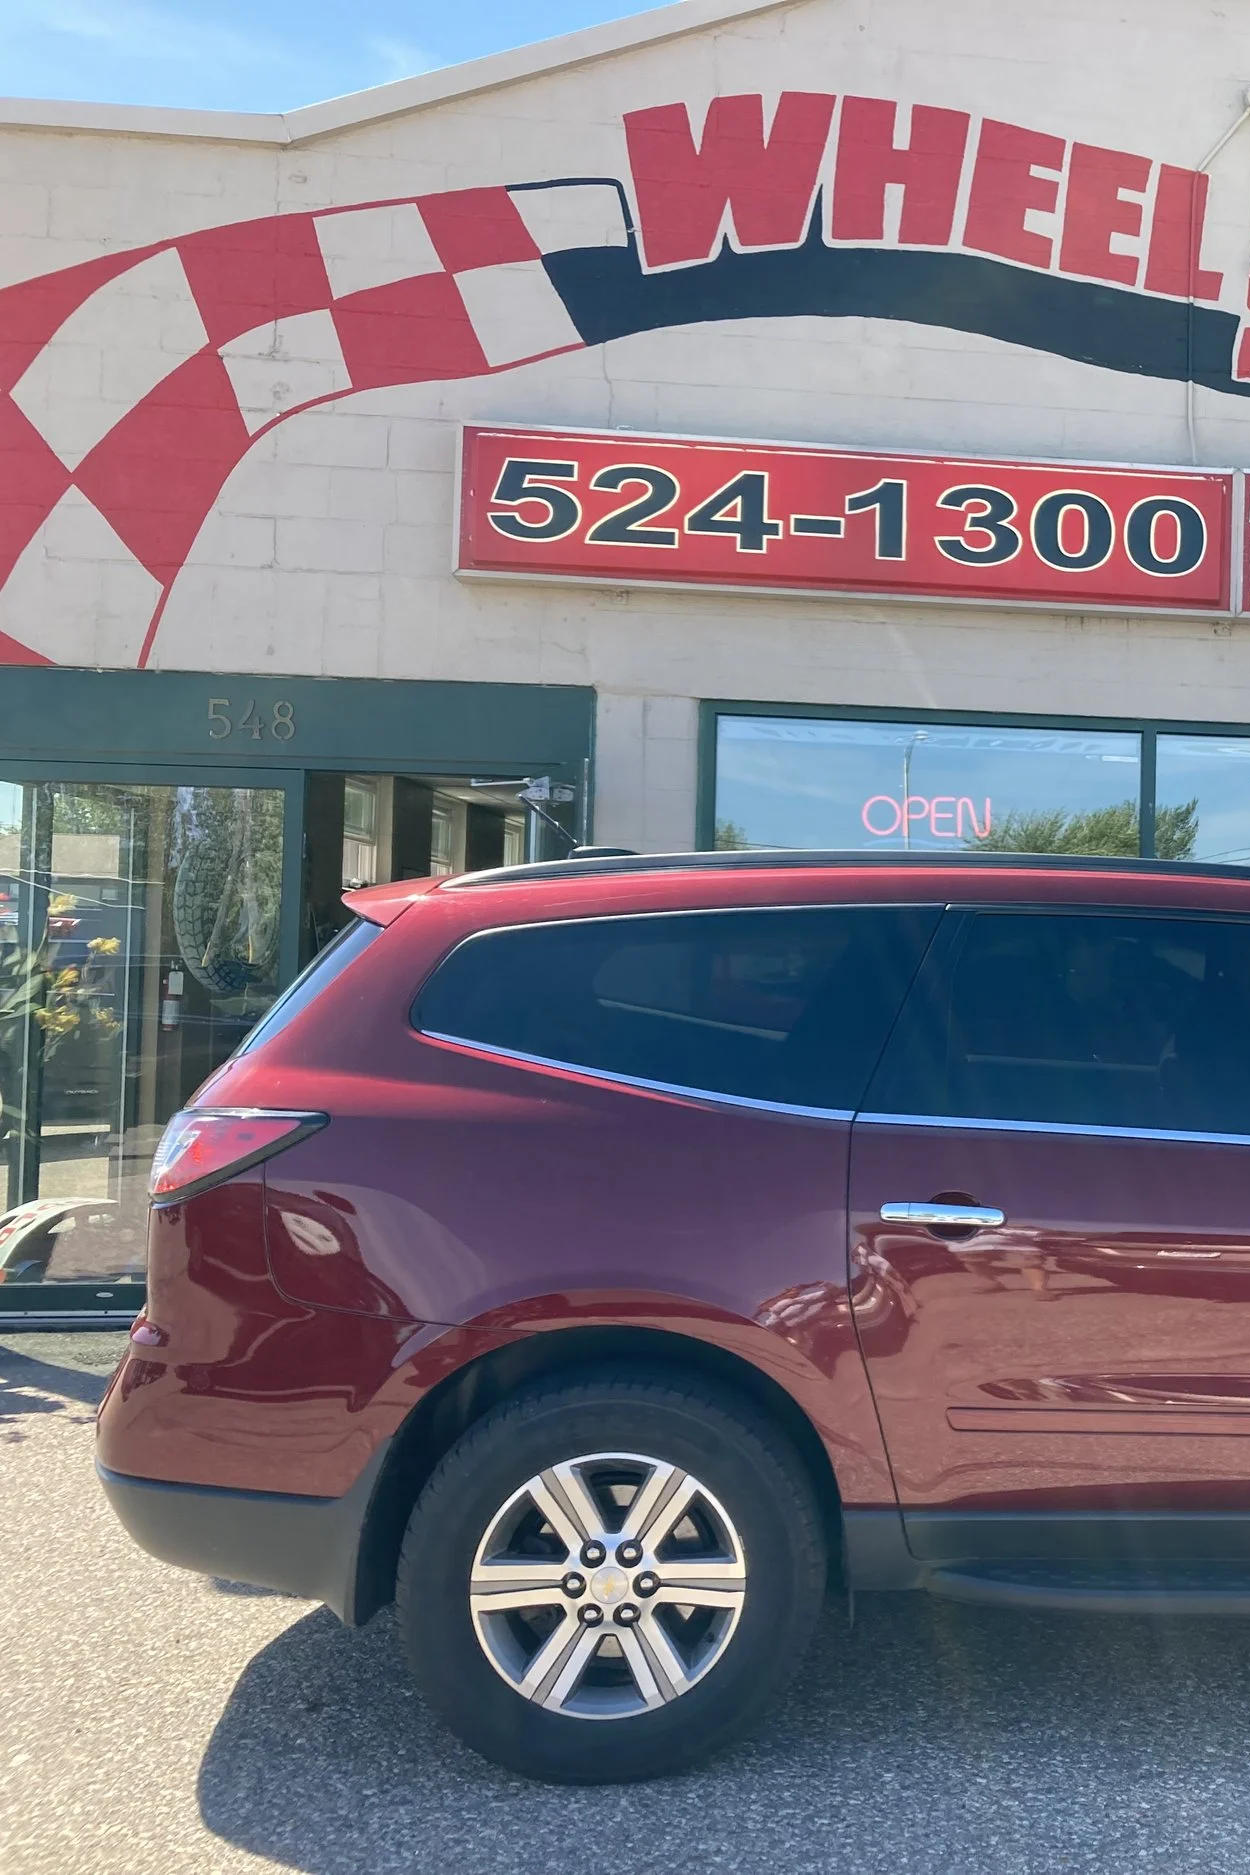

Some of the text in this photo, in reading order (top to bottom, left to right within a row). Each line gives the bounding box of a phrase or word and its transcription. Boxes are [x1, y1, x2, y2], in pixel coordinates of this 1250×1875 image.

[623, 91, 1223, 301] WHEEL
[487, 457, 1207, 577] 524-1300
[207, 698, 296, 740] 548
[861, 795, 992, 838] OPEN
